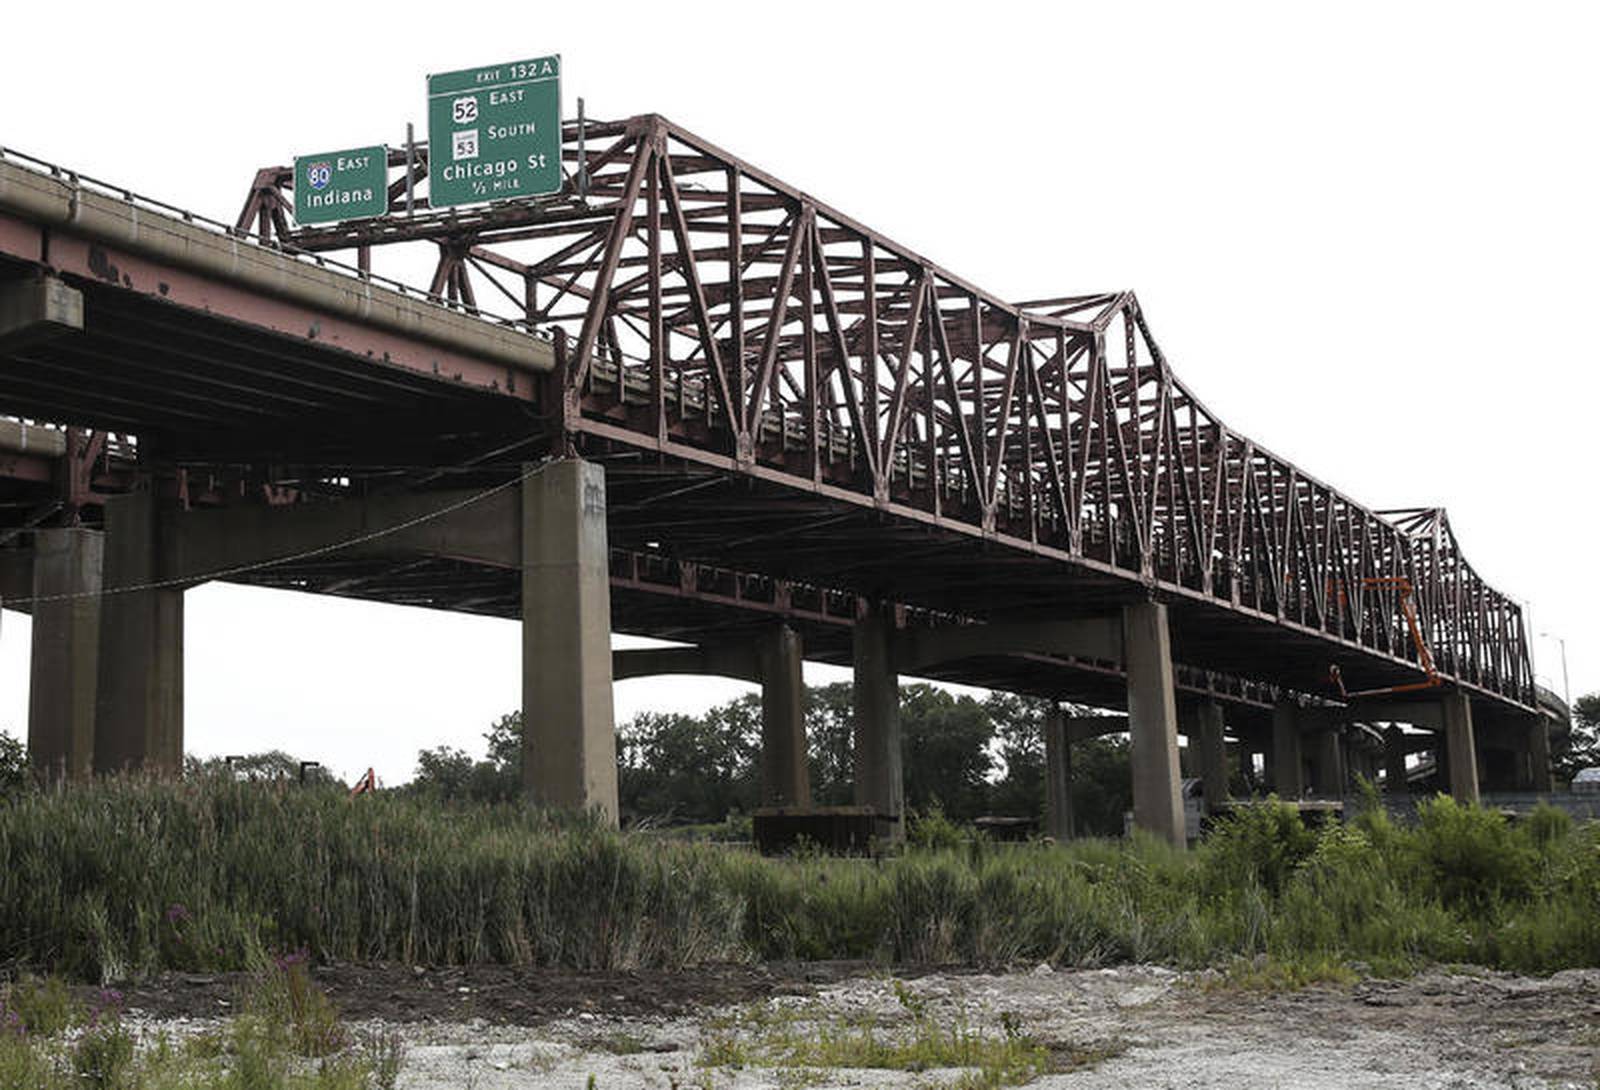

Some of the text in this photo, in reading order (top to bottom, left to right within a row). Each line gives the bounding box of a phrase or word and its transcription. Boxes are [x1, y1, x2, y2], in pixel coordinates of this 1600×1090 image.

[476, 70, 500, 82] EXIT
[510, 63, 537, 79] 132
[489, 90, 524, 105] EAST
[455, 101, 476, 120] 52
[488, 122, 535, 139] SOUTH
[457, 141, 475, 155] 53
[337, 156, 369, 171] EAST
[443, 153, 546, 180] Chicago St
[311, 168, 329, 184] 80
[493, 179, 520, 191] MILE
[307, 188, 372, 208] Indiana
